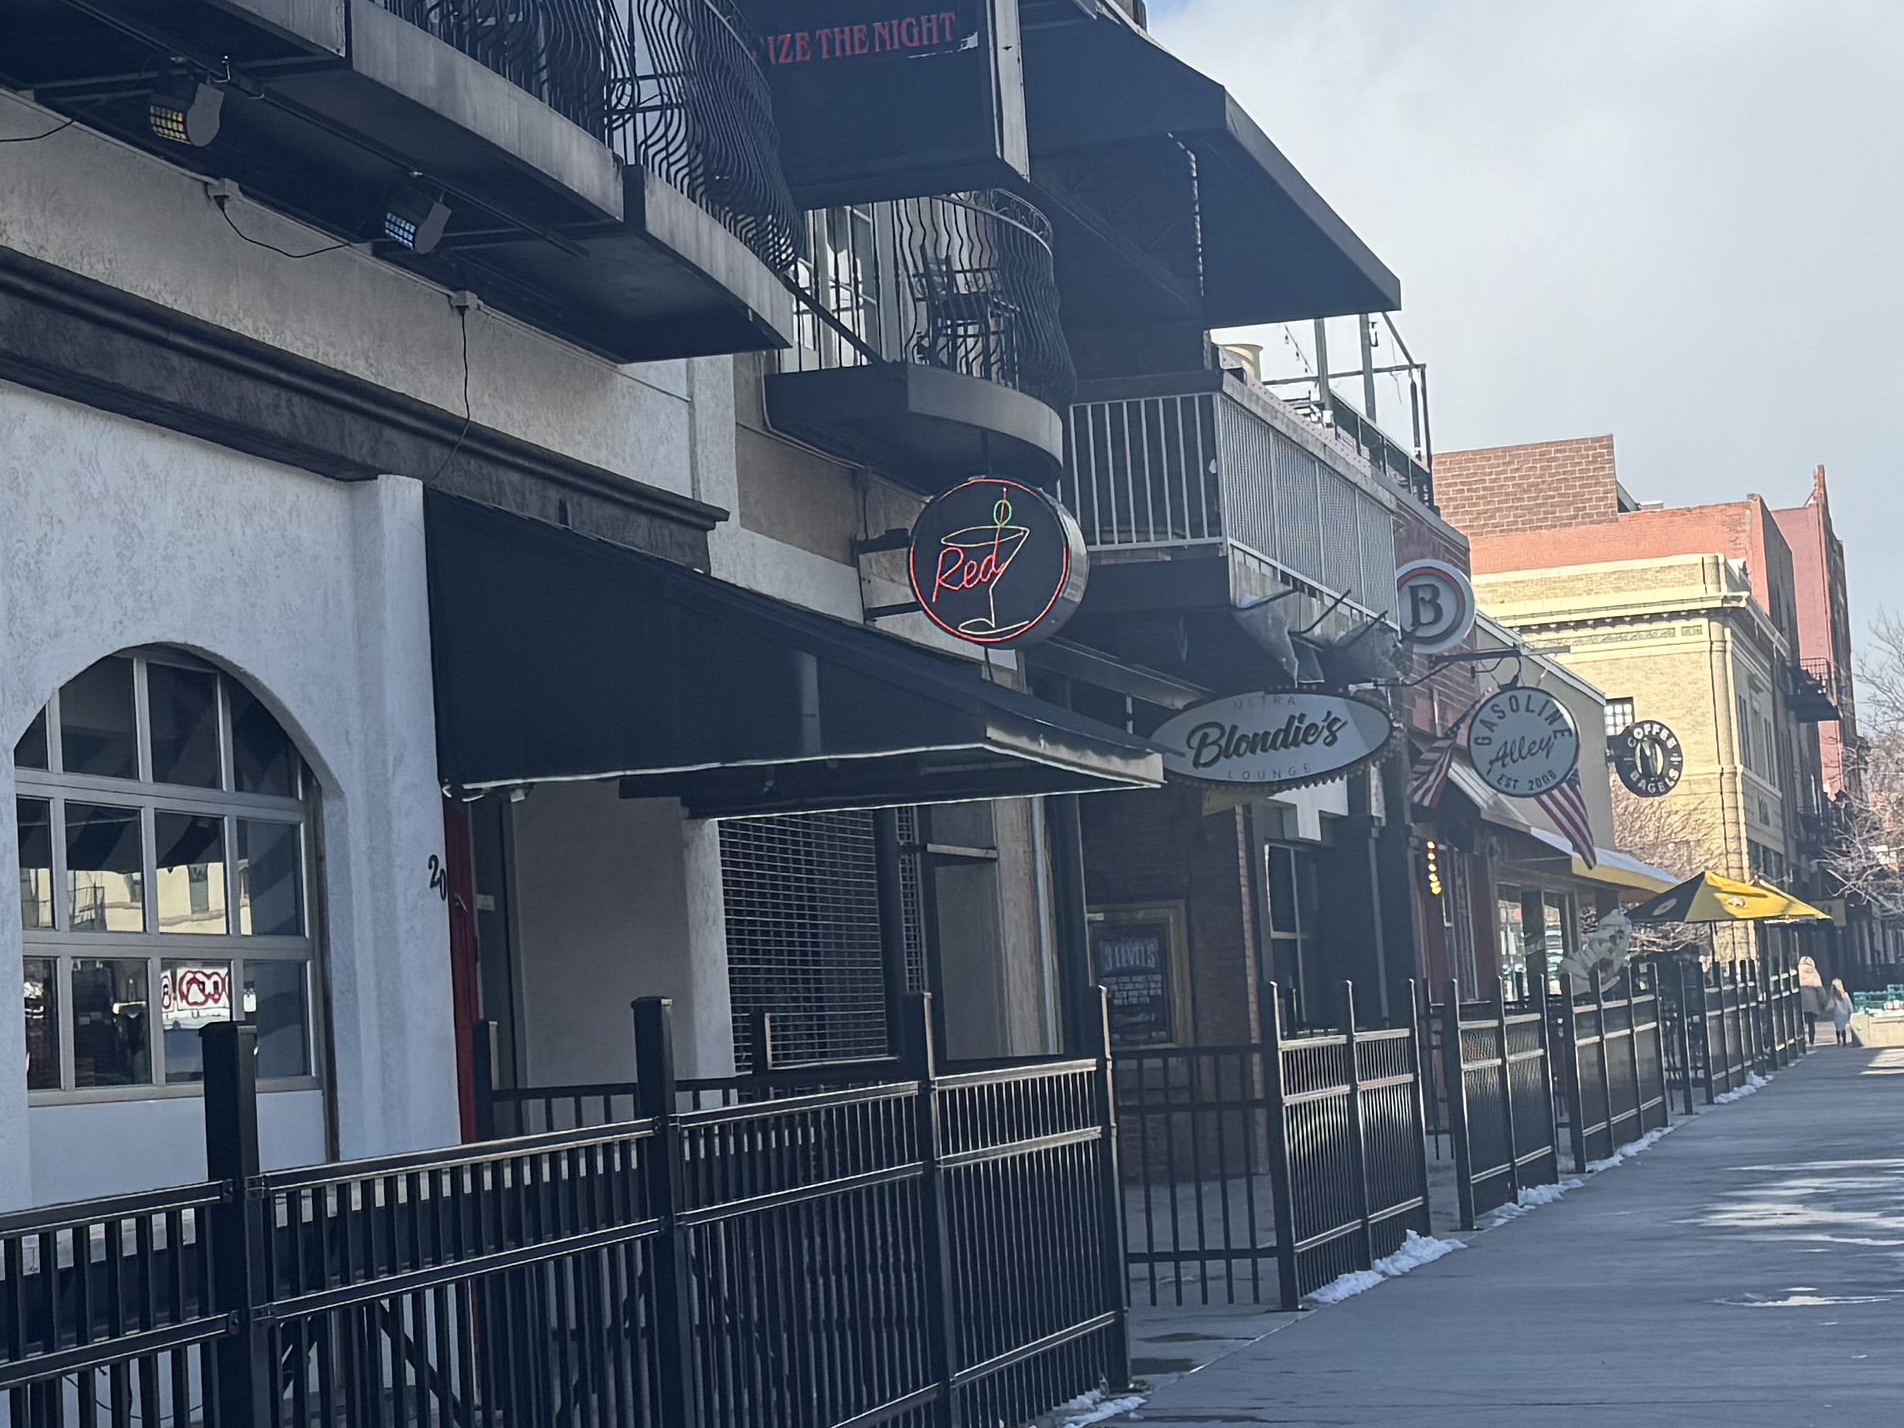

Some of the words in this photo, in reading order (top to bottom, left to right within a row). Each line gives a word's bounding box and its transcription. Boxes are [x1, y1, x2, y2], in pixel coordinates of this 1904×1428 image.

[816, 24, 870, 60] THE
[874, 11, 956, 53] NIGHT
[932, 530, 1007, 603] Red
[1408, 583, 1444, 627] B
[1233, 694, 1297, 710] ULTRA
[1474, 693, 1573, 747] GASOLINE
[1186, 710, 1349, 769] Blondie's
[1486, 734, 1556, 776] Alley
[1627, 722, 1677, 749] COFFEE
[1228, 762, 1313, 780] LOUNGE
[1496, 775, 1518, 790] EST
[1629, 767, 1680, 794] BAGELS
[427, 853, 447, 902] 20
